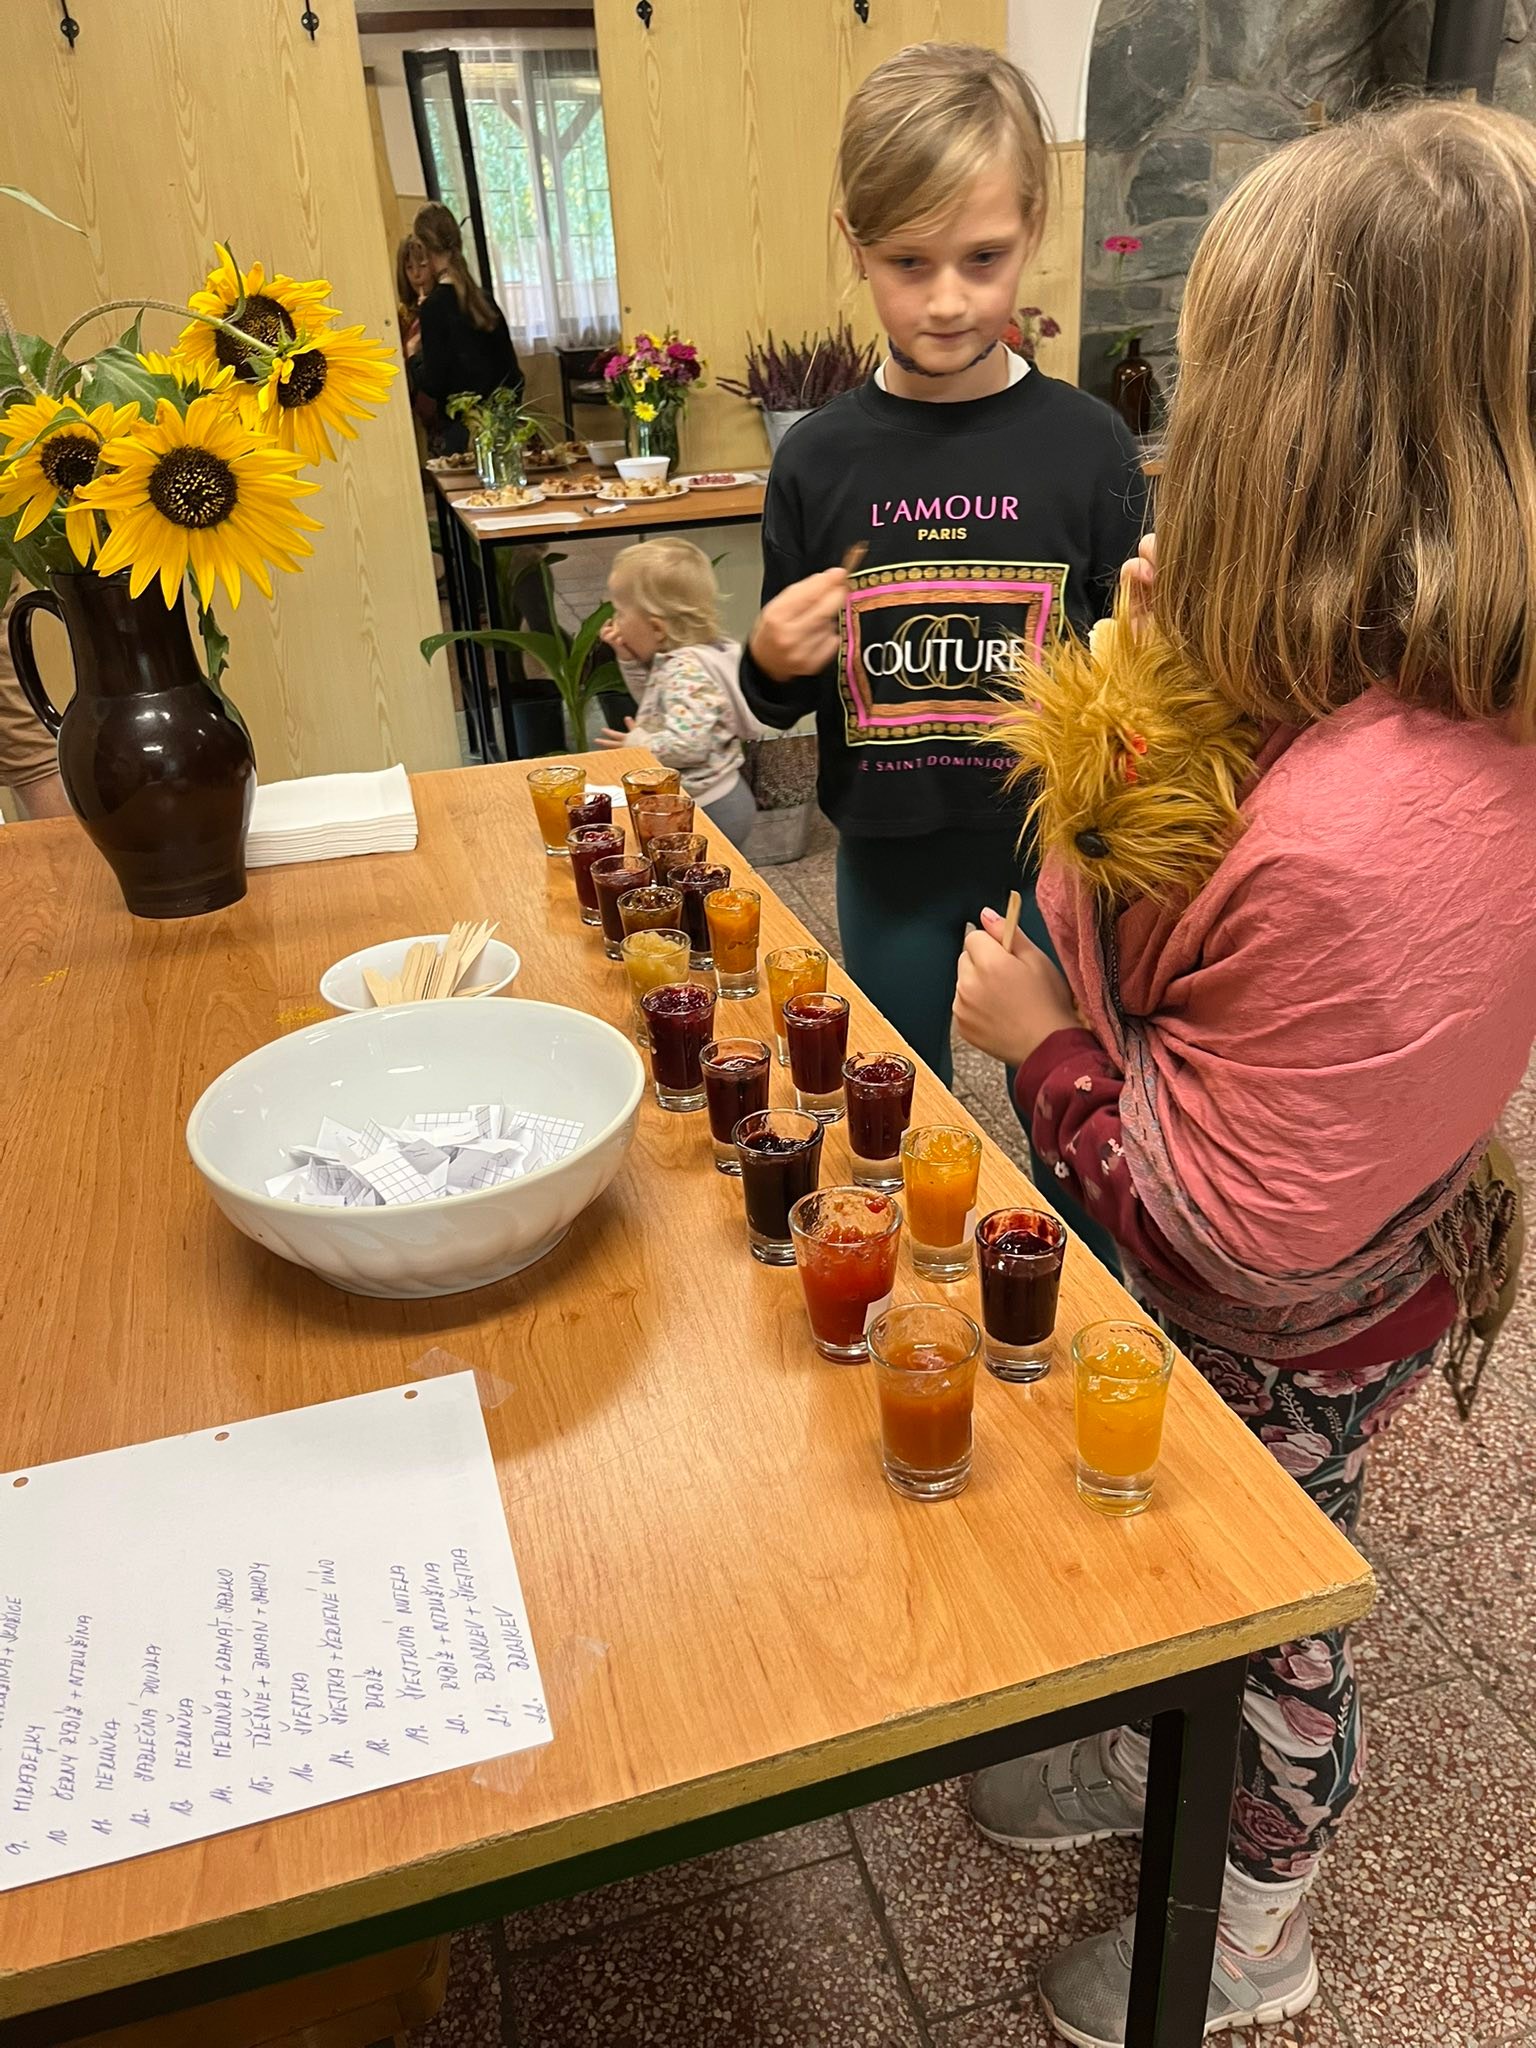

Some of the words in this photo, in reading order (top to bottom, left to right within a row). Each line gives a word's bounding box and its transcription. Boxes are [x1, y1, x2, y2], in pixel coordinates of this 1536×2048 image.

[871, 495, 1018, 526] L'AMOUR
[917, 527, 967, 541] PARIS
[863, 638, 1025, 676] COUTURE
[876, 758, 921, 772] SAINT
[449, 1548, 478, 1601] ŠVESTKA
[201, 1689, 233, 1759] MERUŇKA
[277, 1672, 312, 1735] ŠVESTKA
[318, 1668, 348, 1725] ŠVESTKA
[88, 1717, 121, 1791] MERUŇKA
[166, 1698, 194, 1769] MERUŇKA
[13, 1724, 46, 1812] MIRABELKY
[46, 1748, 79, 1800] ČERNÝ
